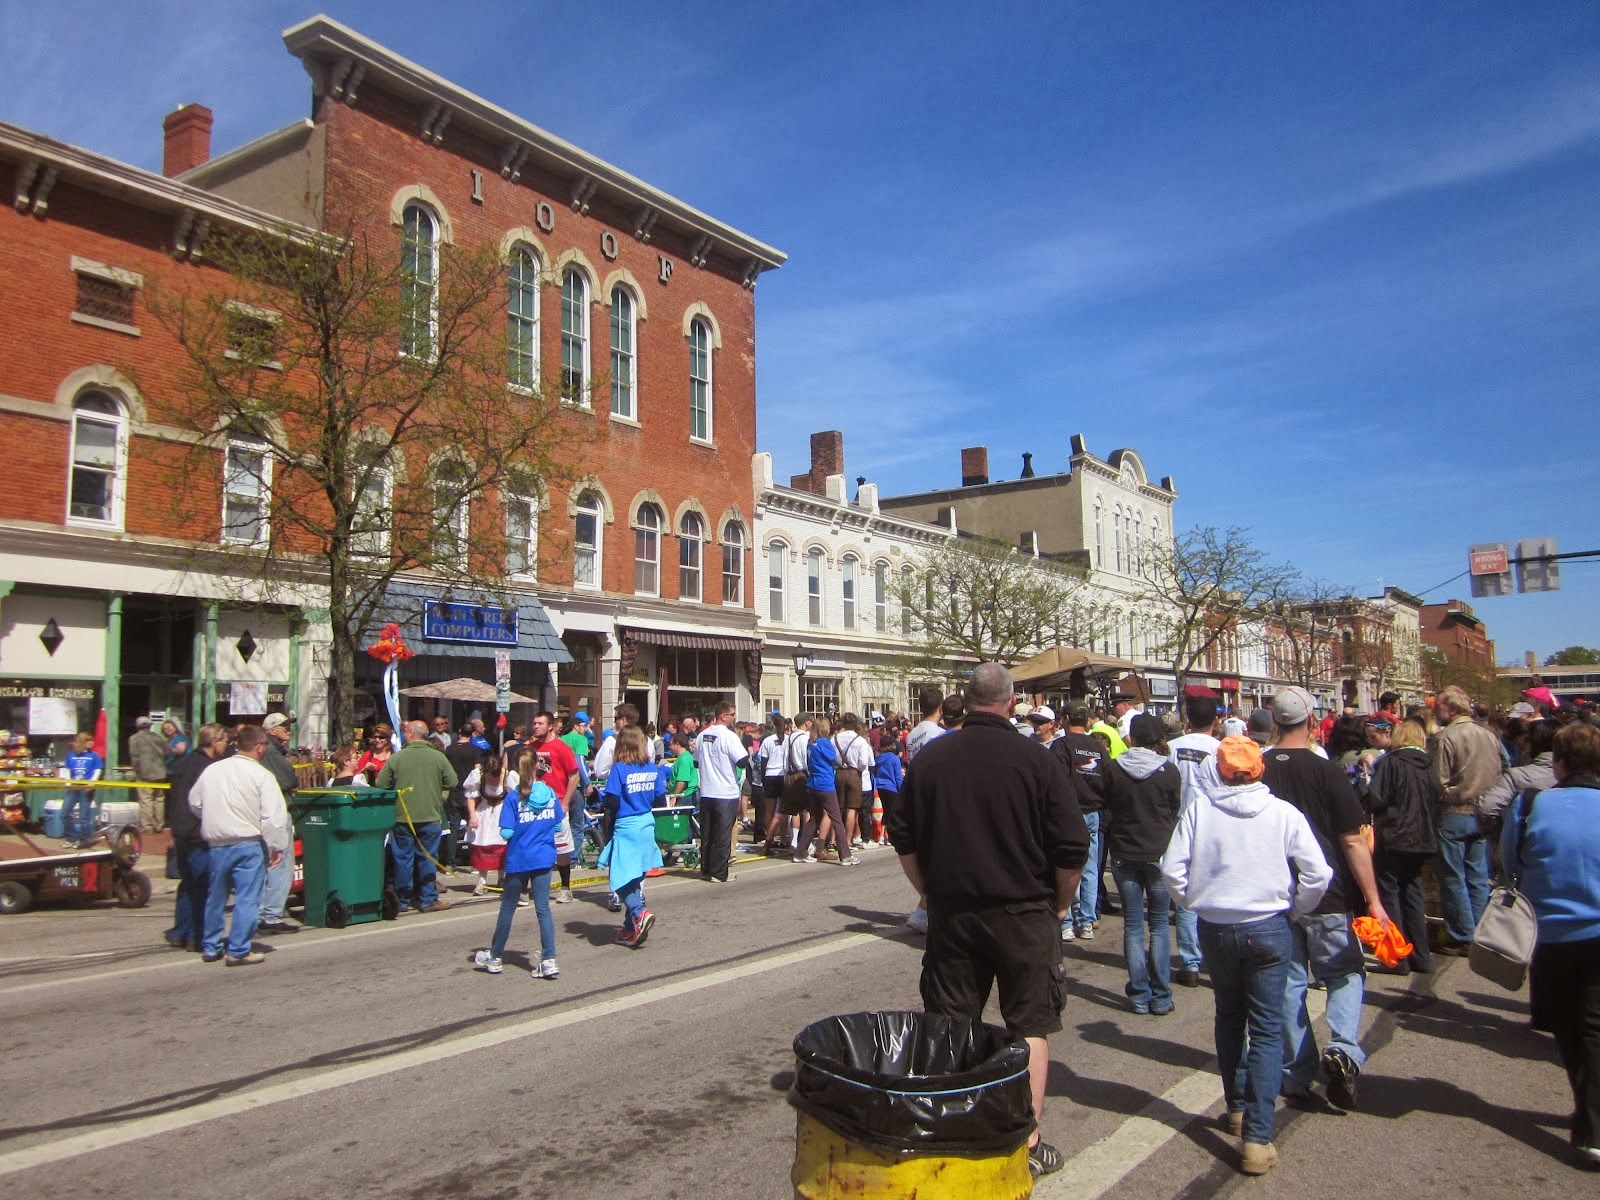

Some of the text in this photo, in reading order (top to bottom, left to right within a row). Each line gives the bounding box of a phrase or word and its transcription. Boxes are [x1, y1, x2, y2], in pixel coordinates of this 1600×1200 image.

[1474, 554, 1502, 563] WRONG
[1481, 563, 1497, 571] WAY
[431, 605, 467, 621] MIN
[431, 622, 513, 640] COMPUTERS
[49, 688, 94, 698] KORNER
